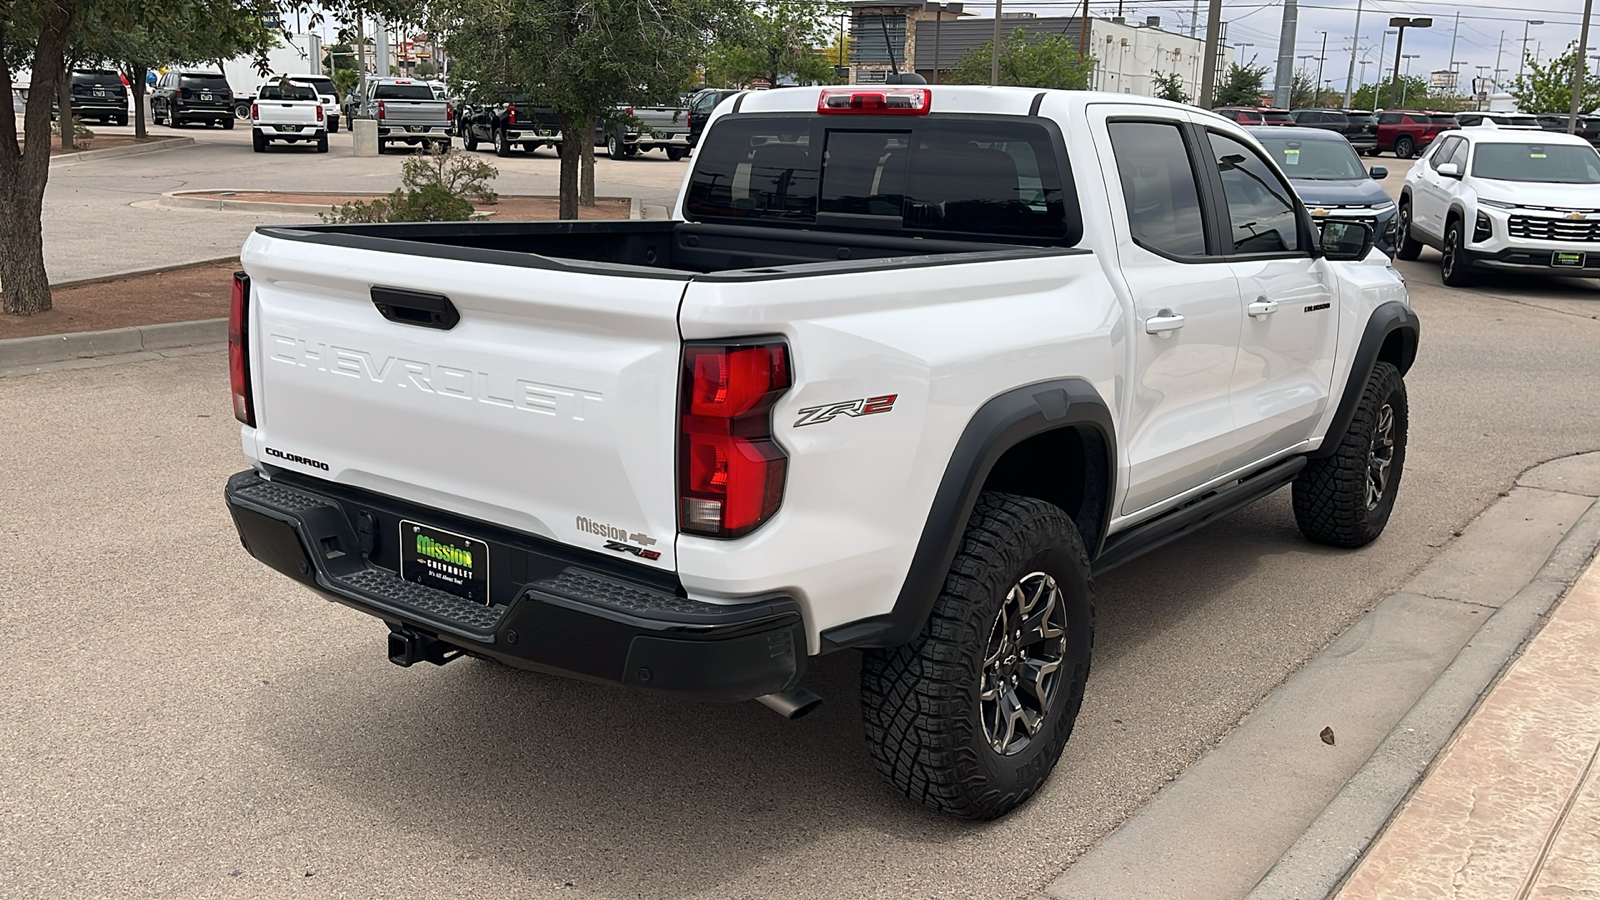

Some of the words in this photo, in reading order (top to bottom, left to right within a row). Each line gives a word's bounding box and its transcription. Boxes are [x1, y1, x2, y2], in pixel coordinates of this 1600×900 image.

[270, 333, 603, 421] CHEVROLET
[793, 394, 898, 428] ZR2
[265, 447, 330, 471] COLORADO
[576, 515, 627, 542] Mission
[417, 534, 472, 568] Mission
[603, 539, 661, 561] ZR2
[427, 560, 473, 579] CHEVROLET
